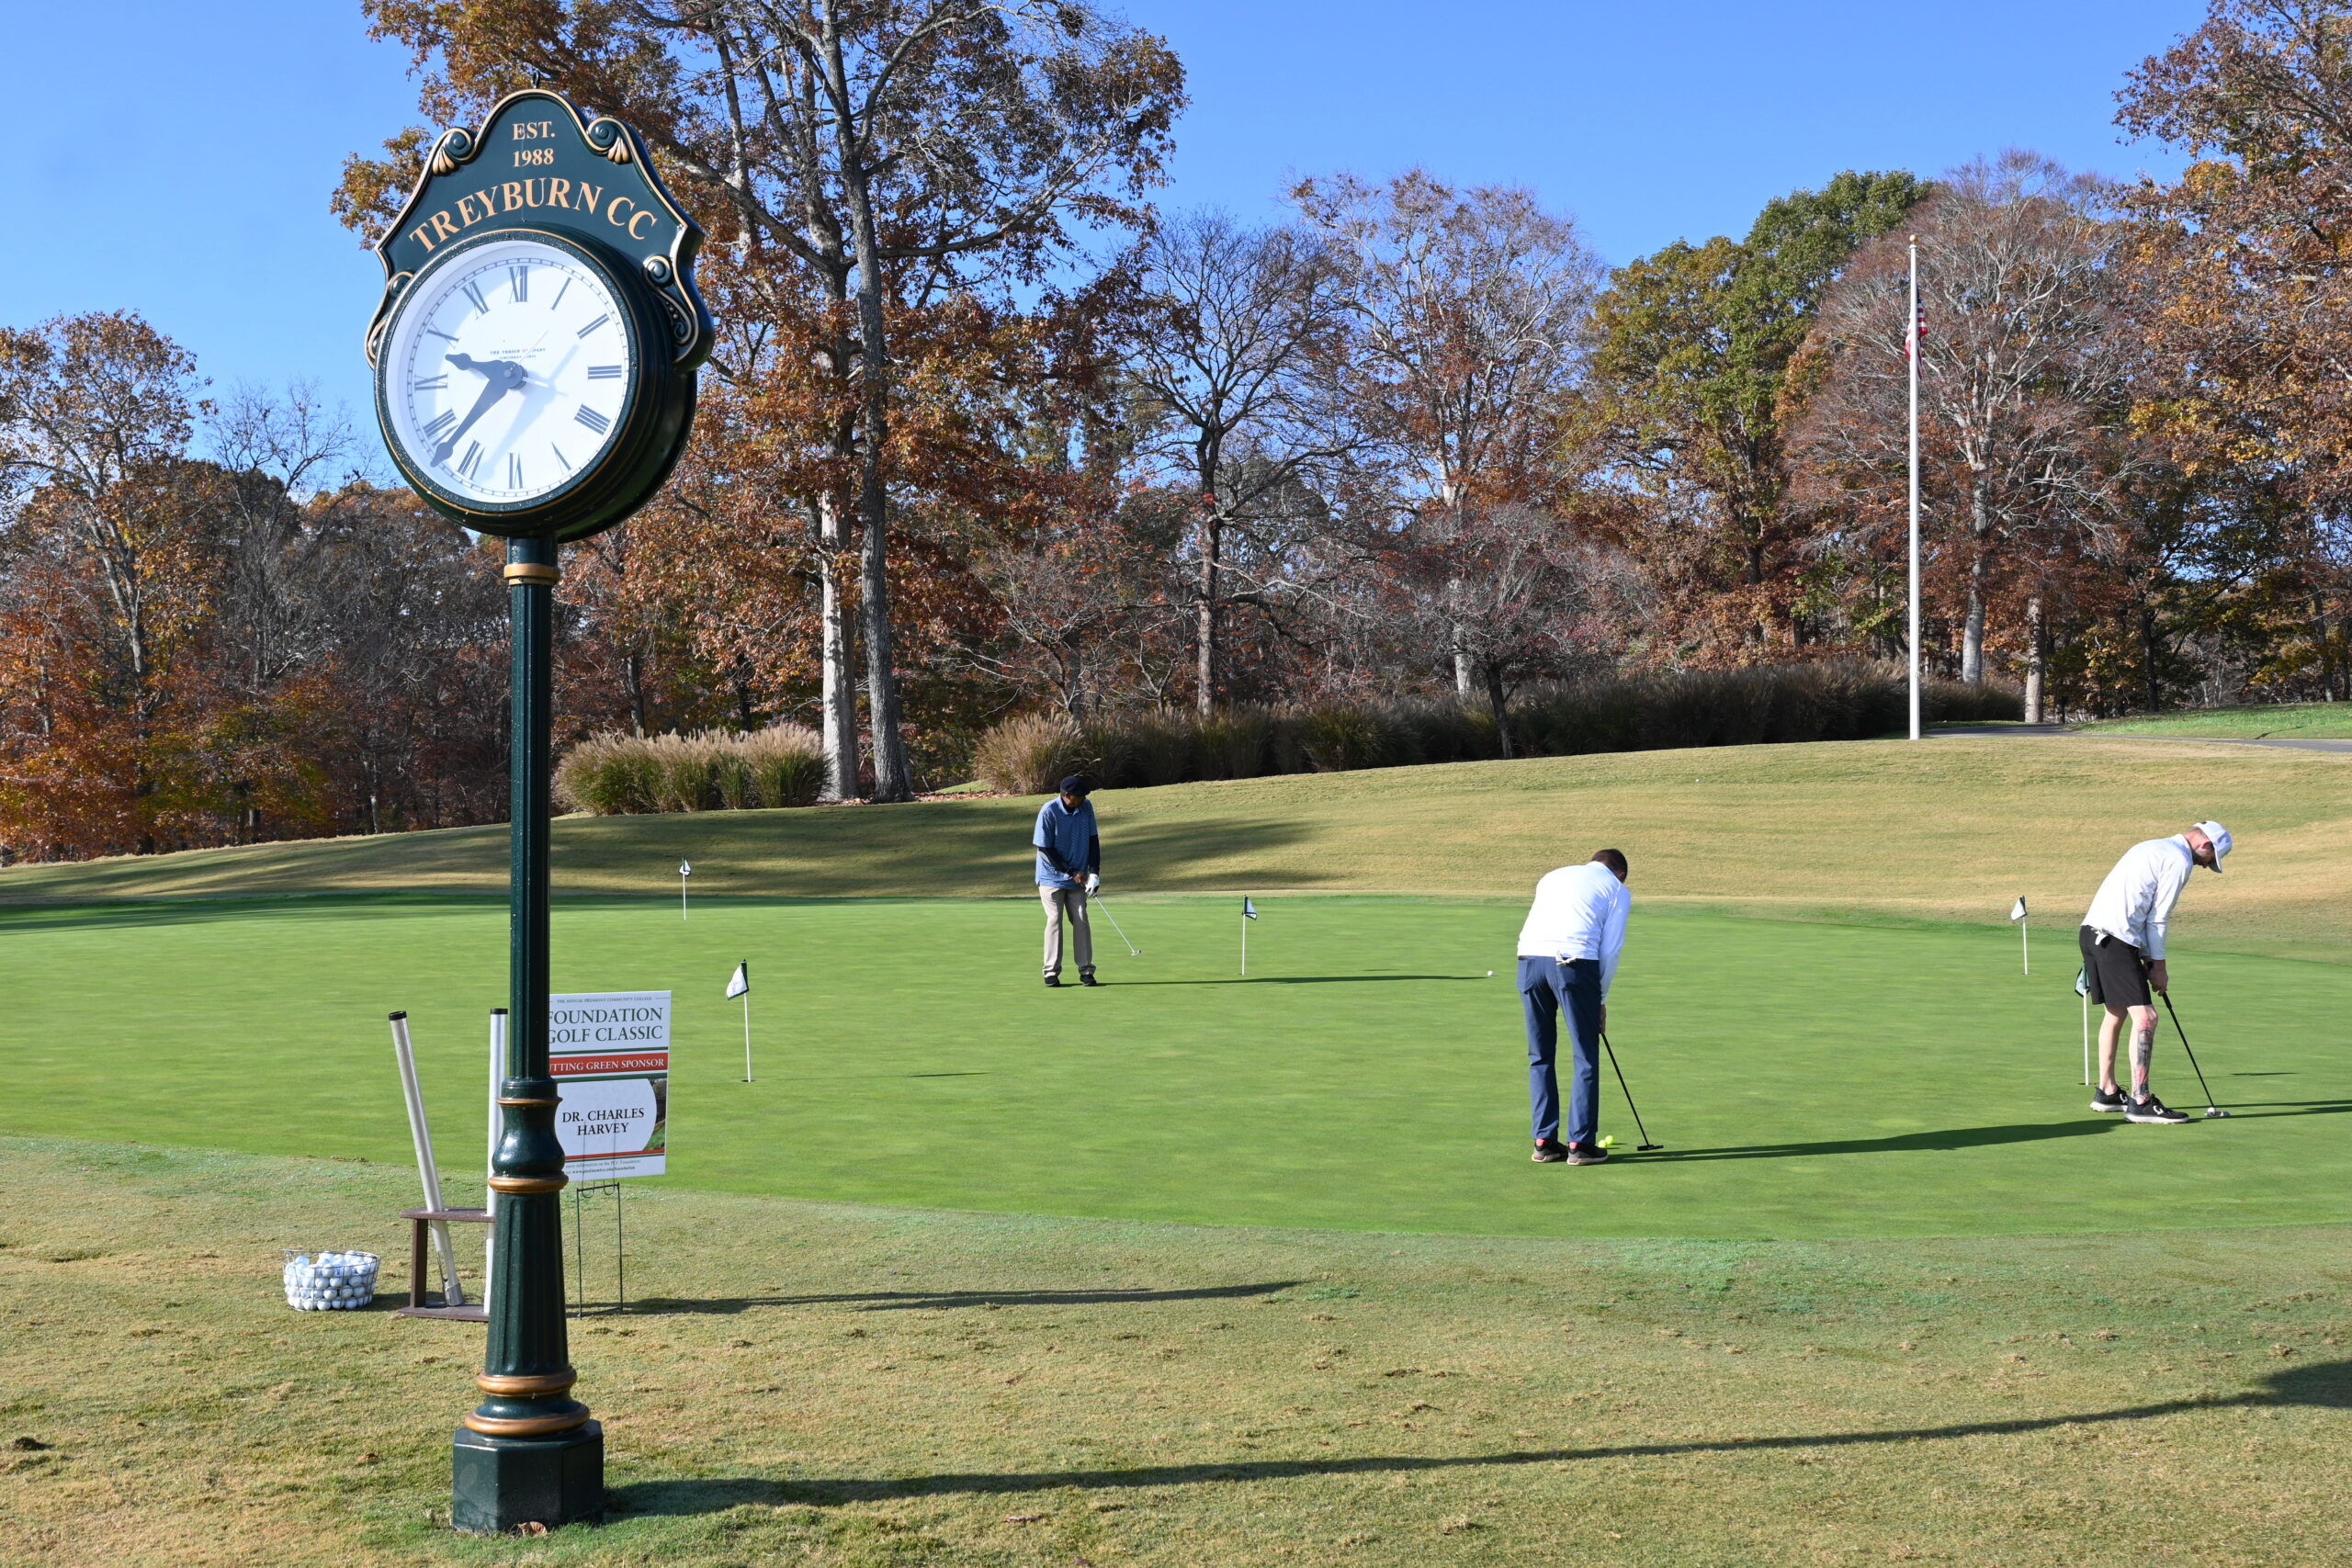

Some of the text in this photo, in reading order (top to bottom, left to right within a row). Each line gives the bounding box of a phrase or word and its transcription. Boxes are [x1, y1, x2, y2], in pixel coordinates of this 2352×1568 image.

[512, 120, 556, 141] EST.
[513, 148, 554, 167] 1988
[408, 177, 658, 254] TREYBURN CC
[595, 1025, 662, 1042] CLASSIC
[549, 1058, 664, 1073] TTING GREEN SPONSOR
[562, 1107, 645, 1122] DR. CHARLES
[577, 1122, 629, 1136] HARVEY
